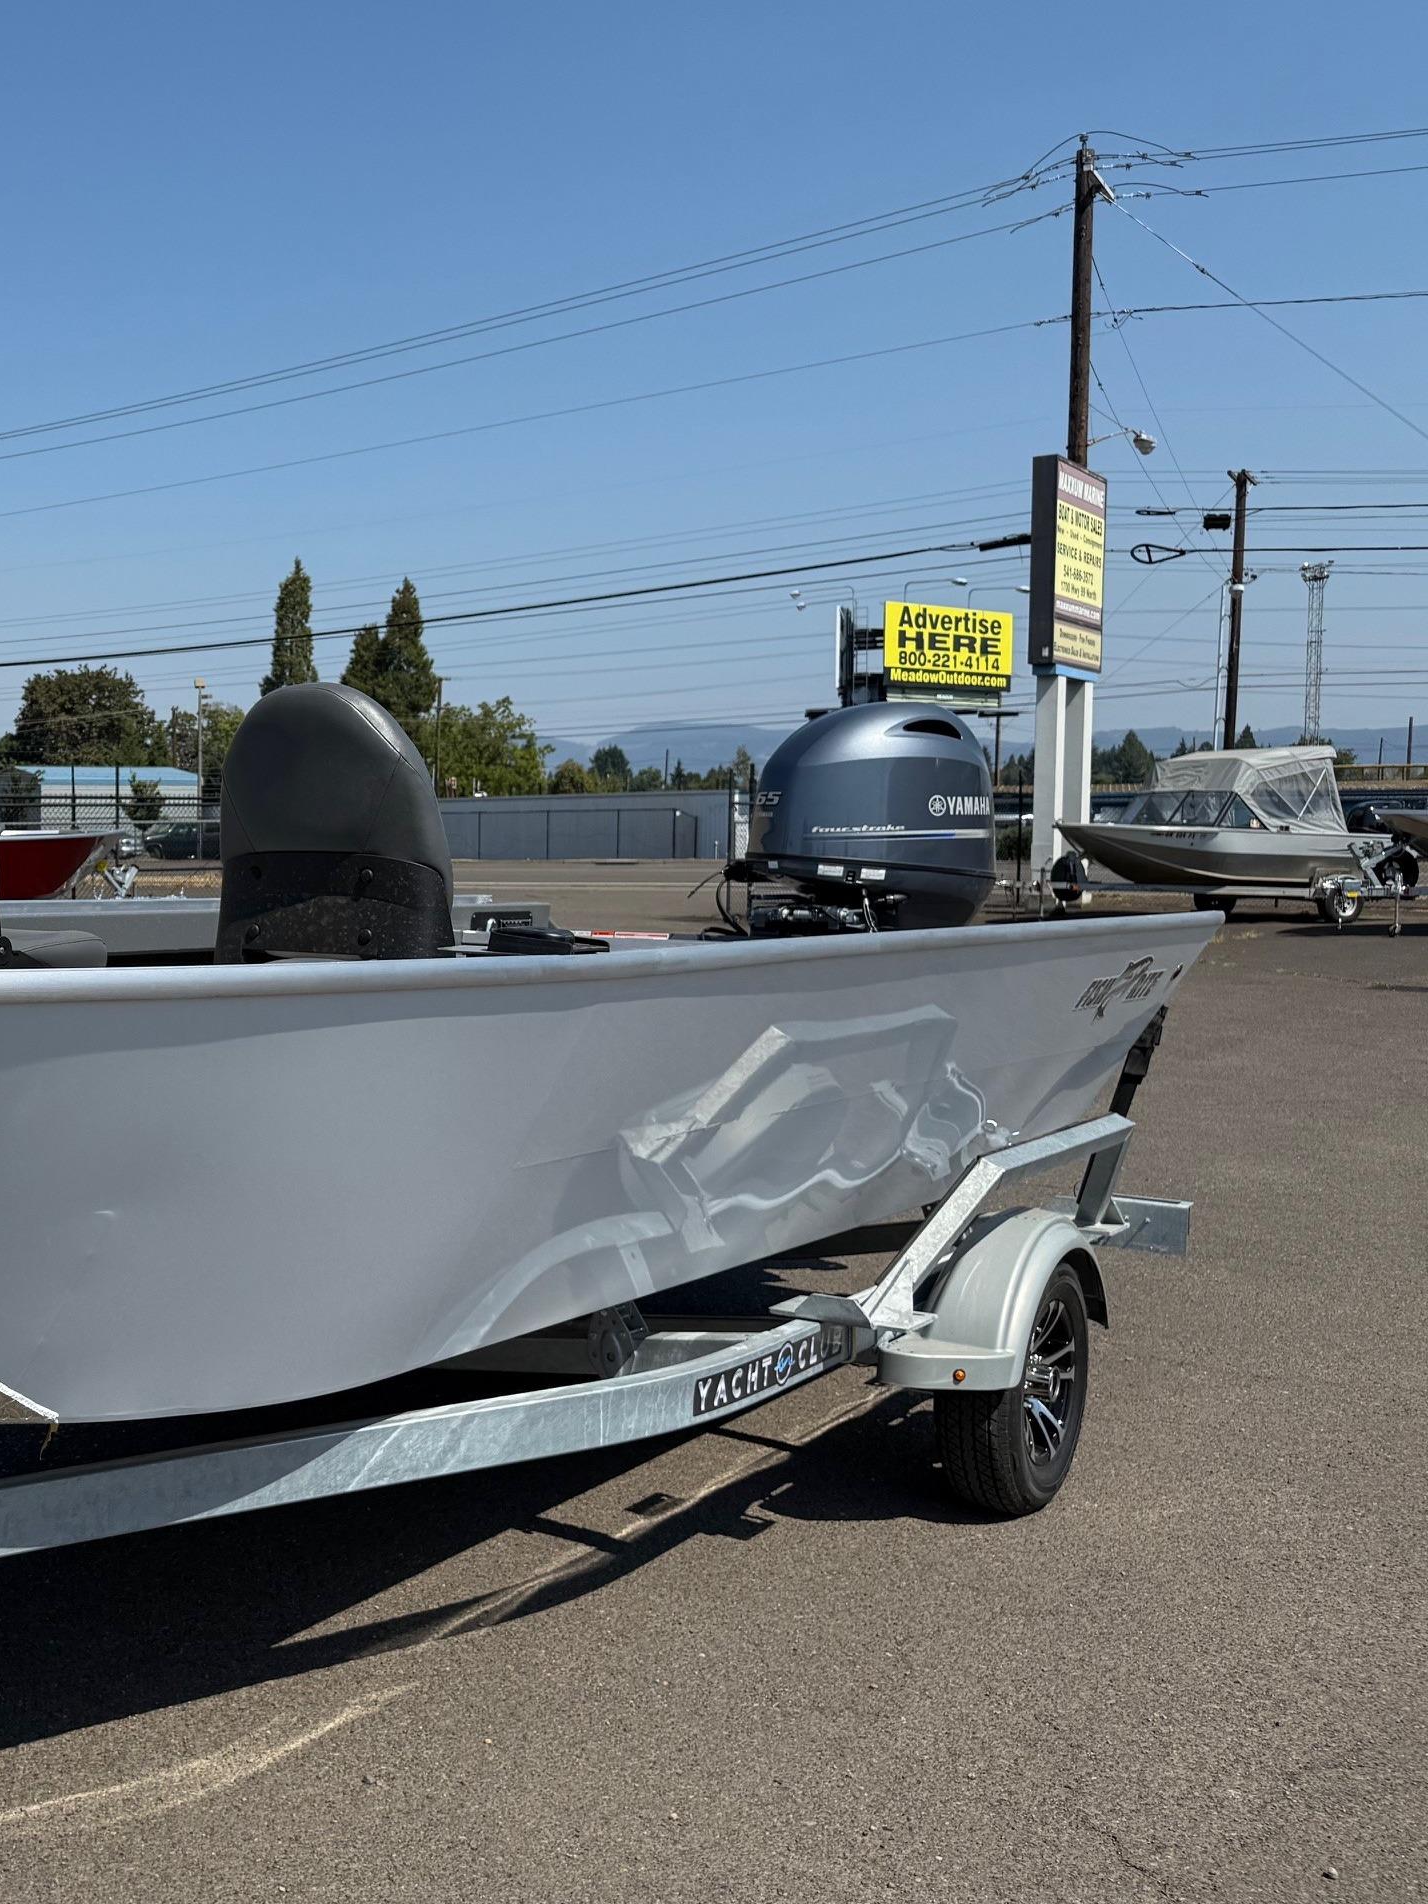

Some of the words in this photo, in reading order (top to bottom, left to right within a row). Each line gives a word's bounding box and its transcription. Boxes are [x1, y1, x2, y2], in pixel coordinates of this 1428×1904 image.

[1058, 470, 1083, 500] MAXXUM
[1083, 482, 1104, 509] MARINE
[1058, 503, 1070, 522] BOAT
[1075, 511, 1090, 532] MOTOR
[1090, 517, 1103, 536] SALES
[1057, 542, 1077, 560] SERVICE
[1083, 551, 1102, 568] REPAIRS
[899, 606, 1002, 635] Advertise
[898, 630, 1002, 656] HERE
[898, 651, 1000, 671] 800-221-4114
[890, 668, 1007, 687] MeadowOutdoor.com
[947, 796, 991, 816] YAMAHA
[1075, 978, 1118, 1009] FISH
[1125, 971, 1165, 1000] RITE
[698, 1355, 772, 1411] YACHT
[798, 1326, 842, 1369] CLUB
